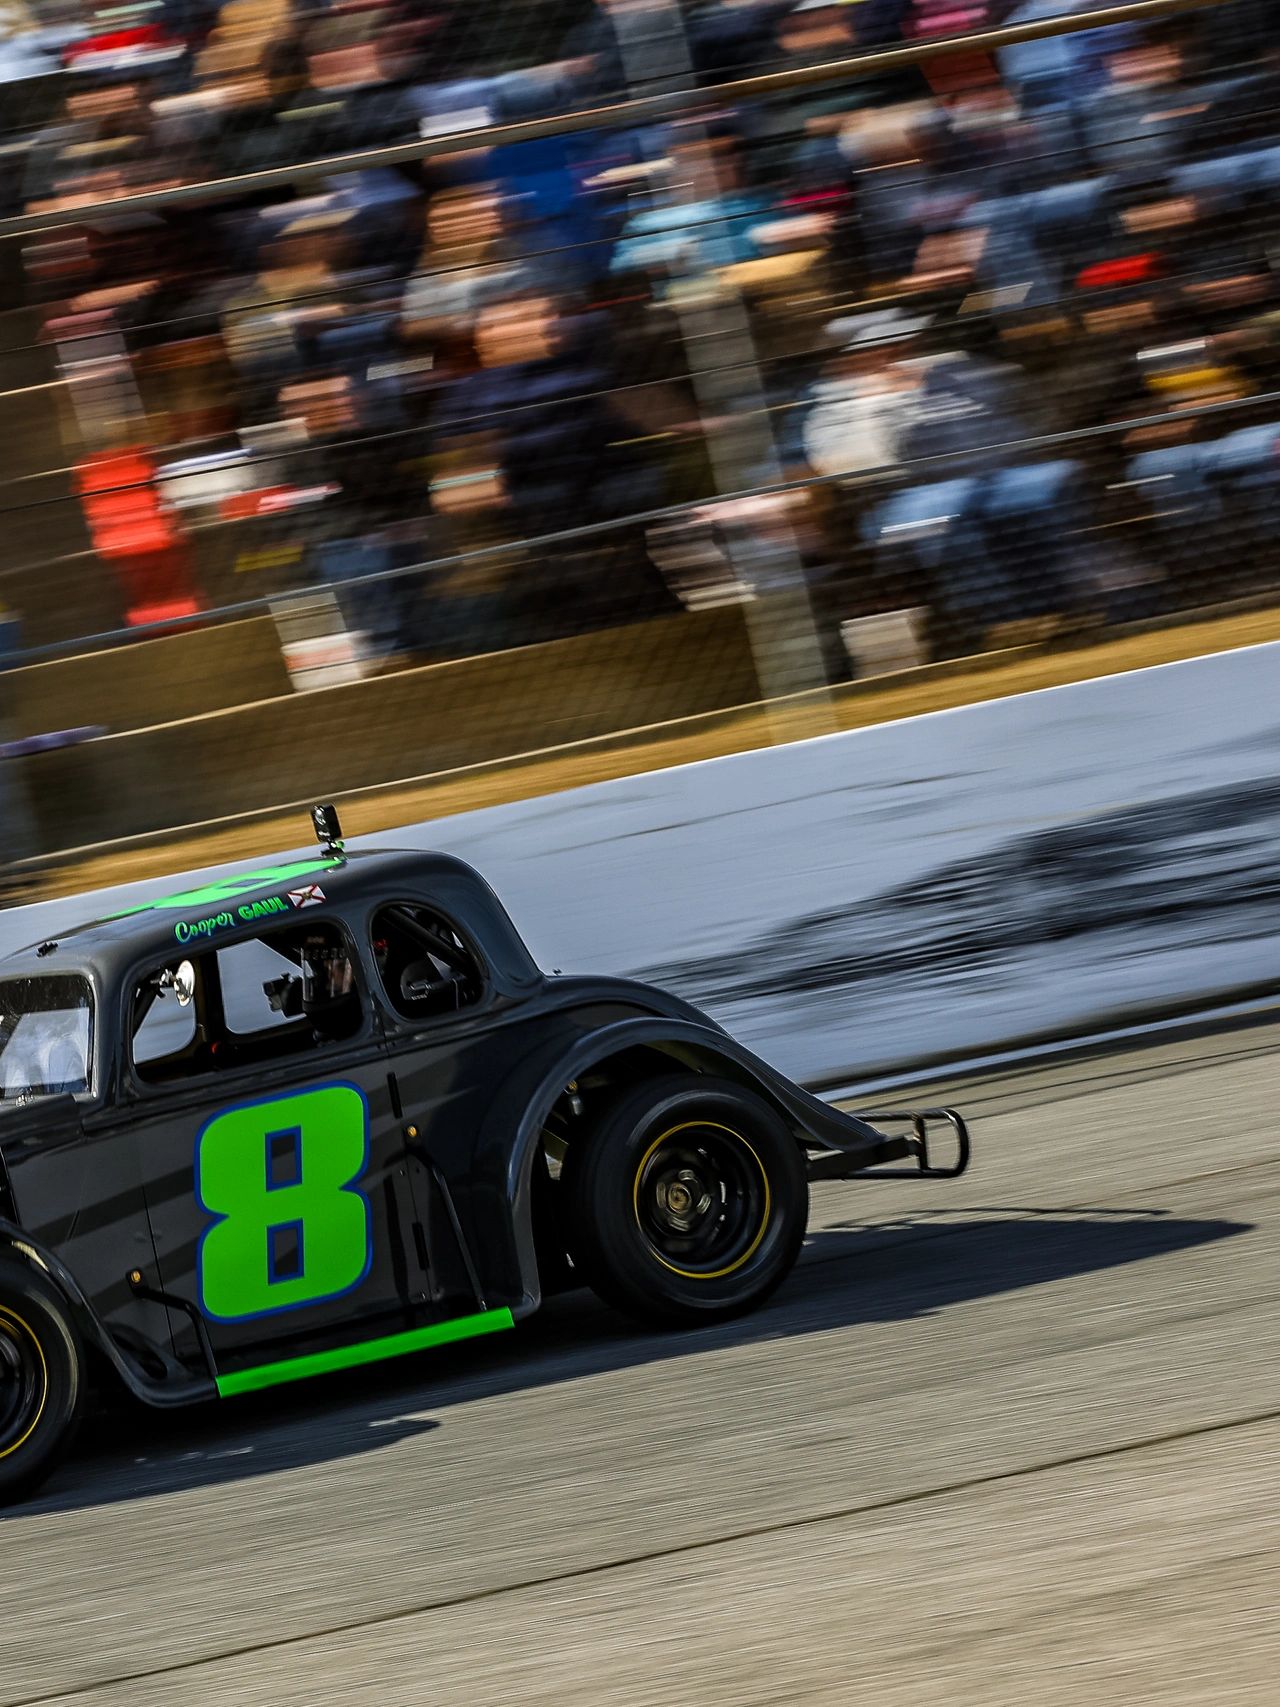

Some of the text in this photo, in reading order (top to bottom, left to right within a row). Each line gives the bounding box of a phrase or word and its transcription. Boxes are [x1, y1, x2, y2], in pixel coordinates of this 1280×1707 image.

[175, 896, 288, 943] Cooper GAUL
[197, 1080, 371, 1323] 8
